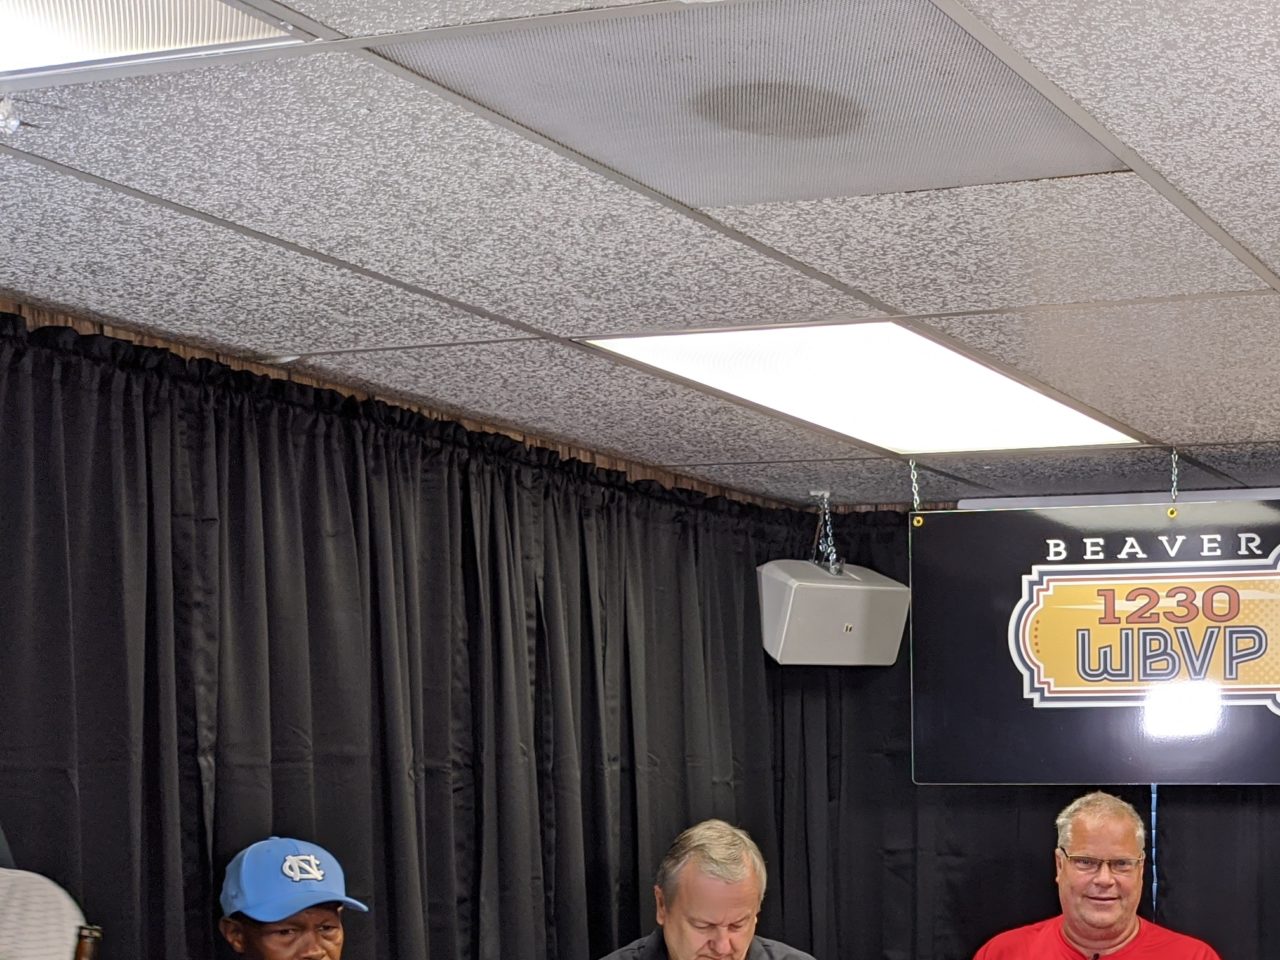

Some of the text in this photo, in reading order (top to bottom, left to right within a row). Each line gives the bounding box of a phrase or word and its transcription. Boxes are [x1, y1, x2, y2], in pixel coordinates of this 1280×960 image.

[1046, 533, 1263, 561] BEAVER
[1096, 585, 1241, 625] 1230
[1076, 625, 1268, 683] WBVP
